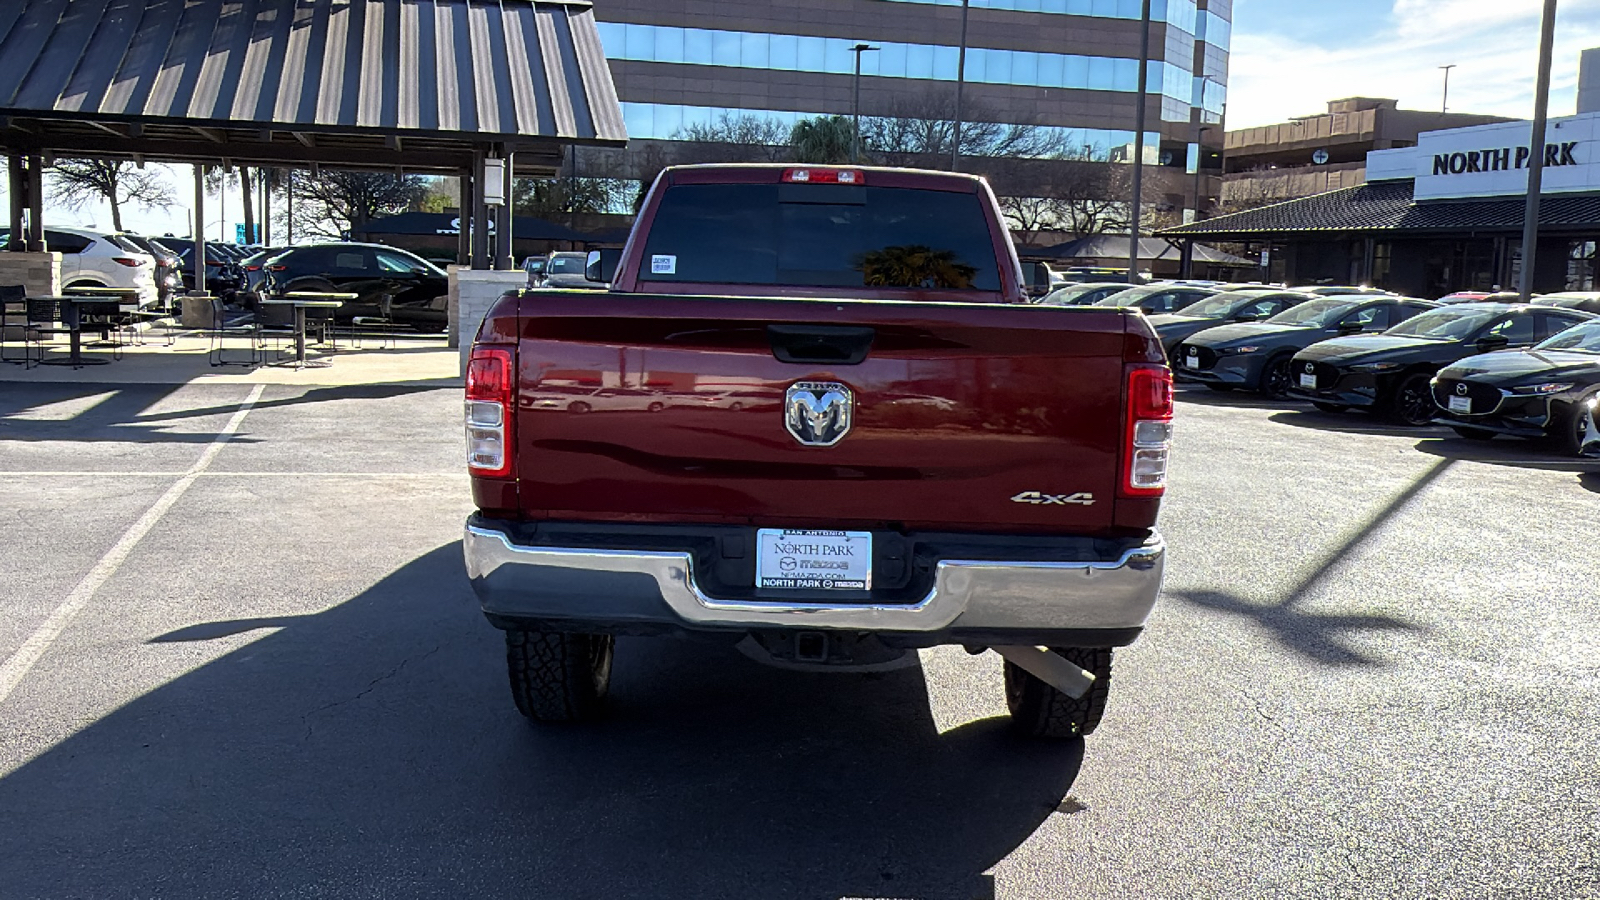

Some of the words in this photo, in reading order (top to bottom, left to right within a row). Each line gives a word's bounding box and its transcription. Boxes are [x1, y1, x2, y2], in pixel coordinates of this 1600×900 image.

[1433, 148, 1510, 175] NORTH
[1515, 141, 1578, 169] PRK
[774, 542, 819, 556] NORTH
[822, 544, 854, 556] PARK
[800, 559, 849, 570] mazda
[763, 579, 795, 587] NORTH
[797, 579, 821, 588] PARK
